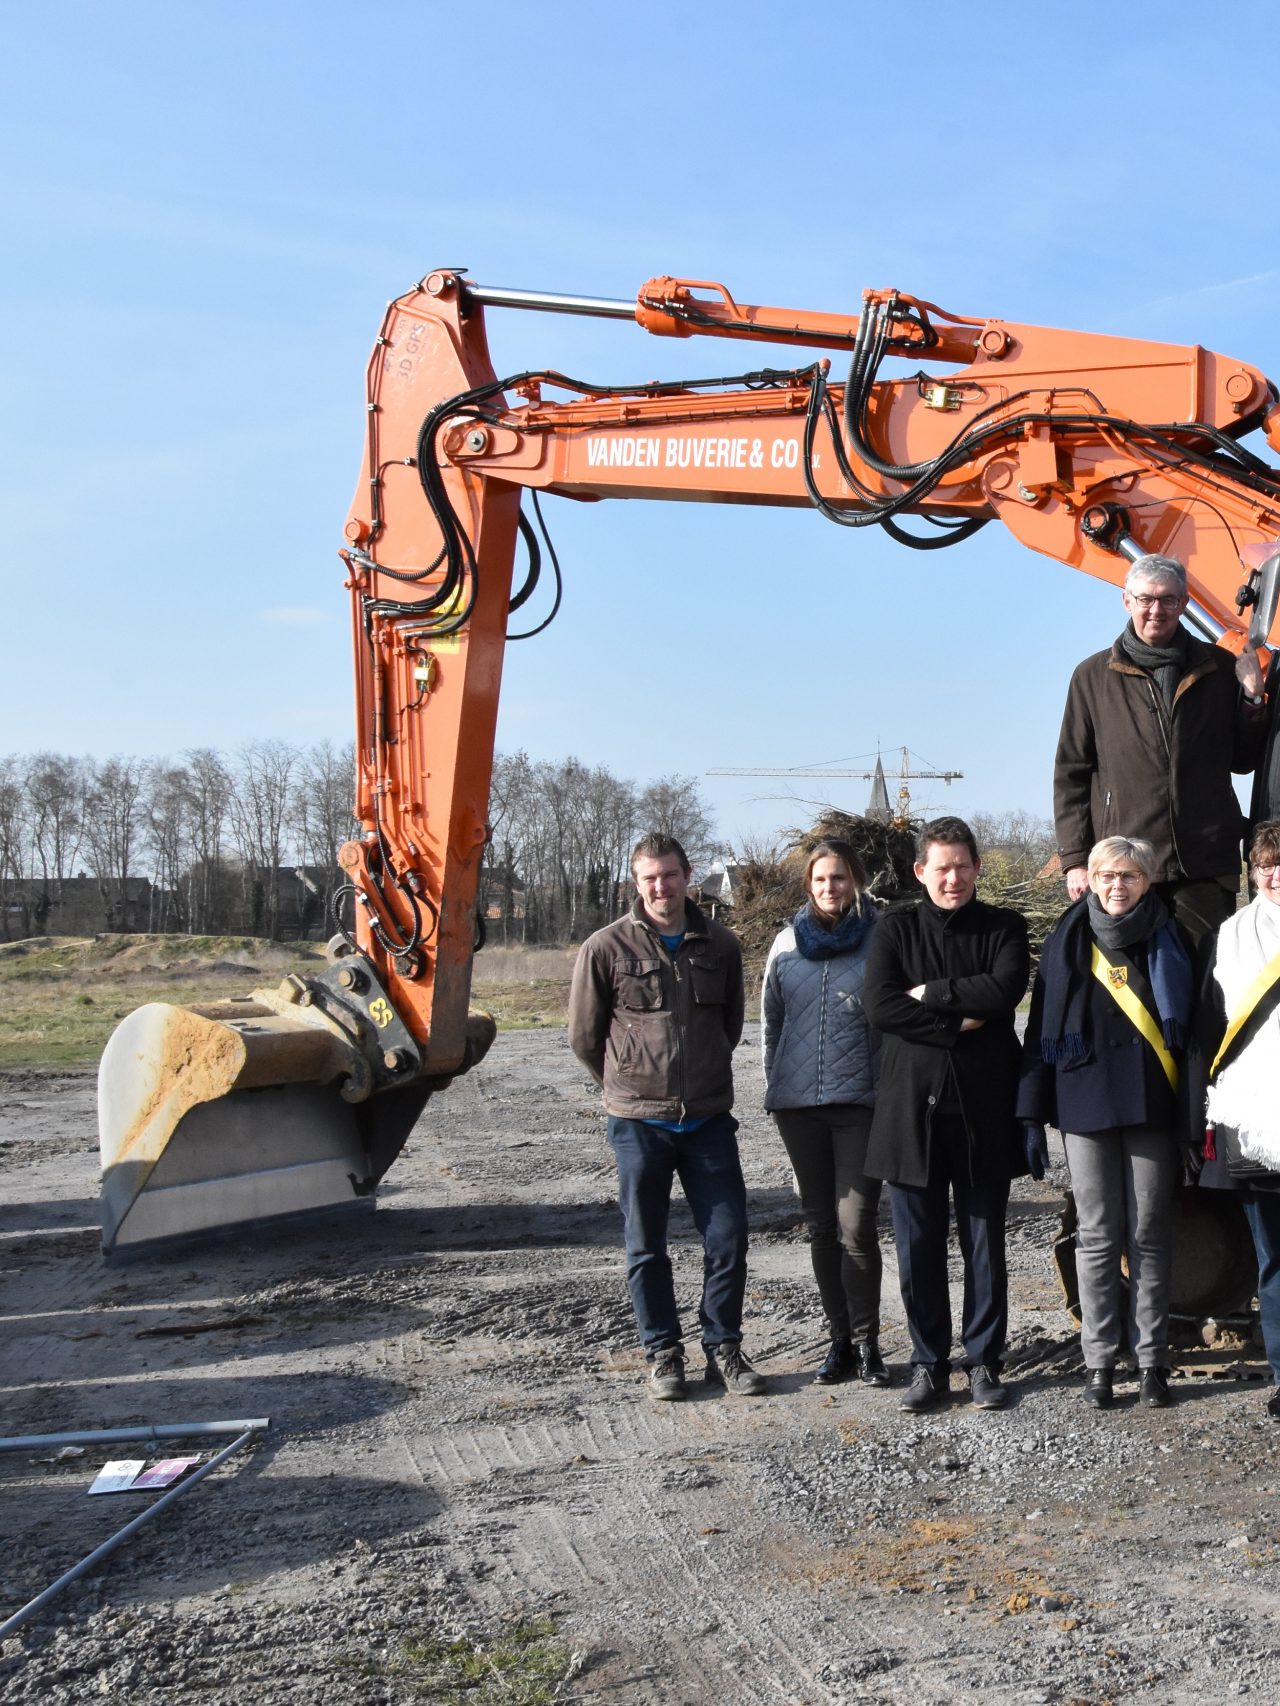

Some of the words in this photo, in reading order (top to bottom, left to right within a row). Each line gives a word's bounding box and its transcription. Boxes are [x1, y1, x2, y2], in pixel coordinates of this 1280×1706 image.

[405, 324, 425, 354] GPS
[587, 438, 660, 467] VANDEN
[665, 438, 748, 468] BUVERIE
[749, 438, 764, 468] &
[771, 438, 799, 468] CO
